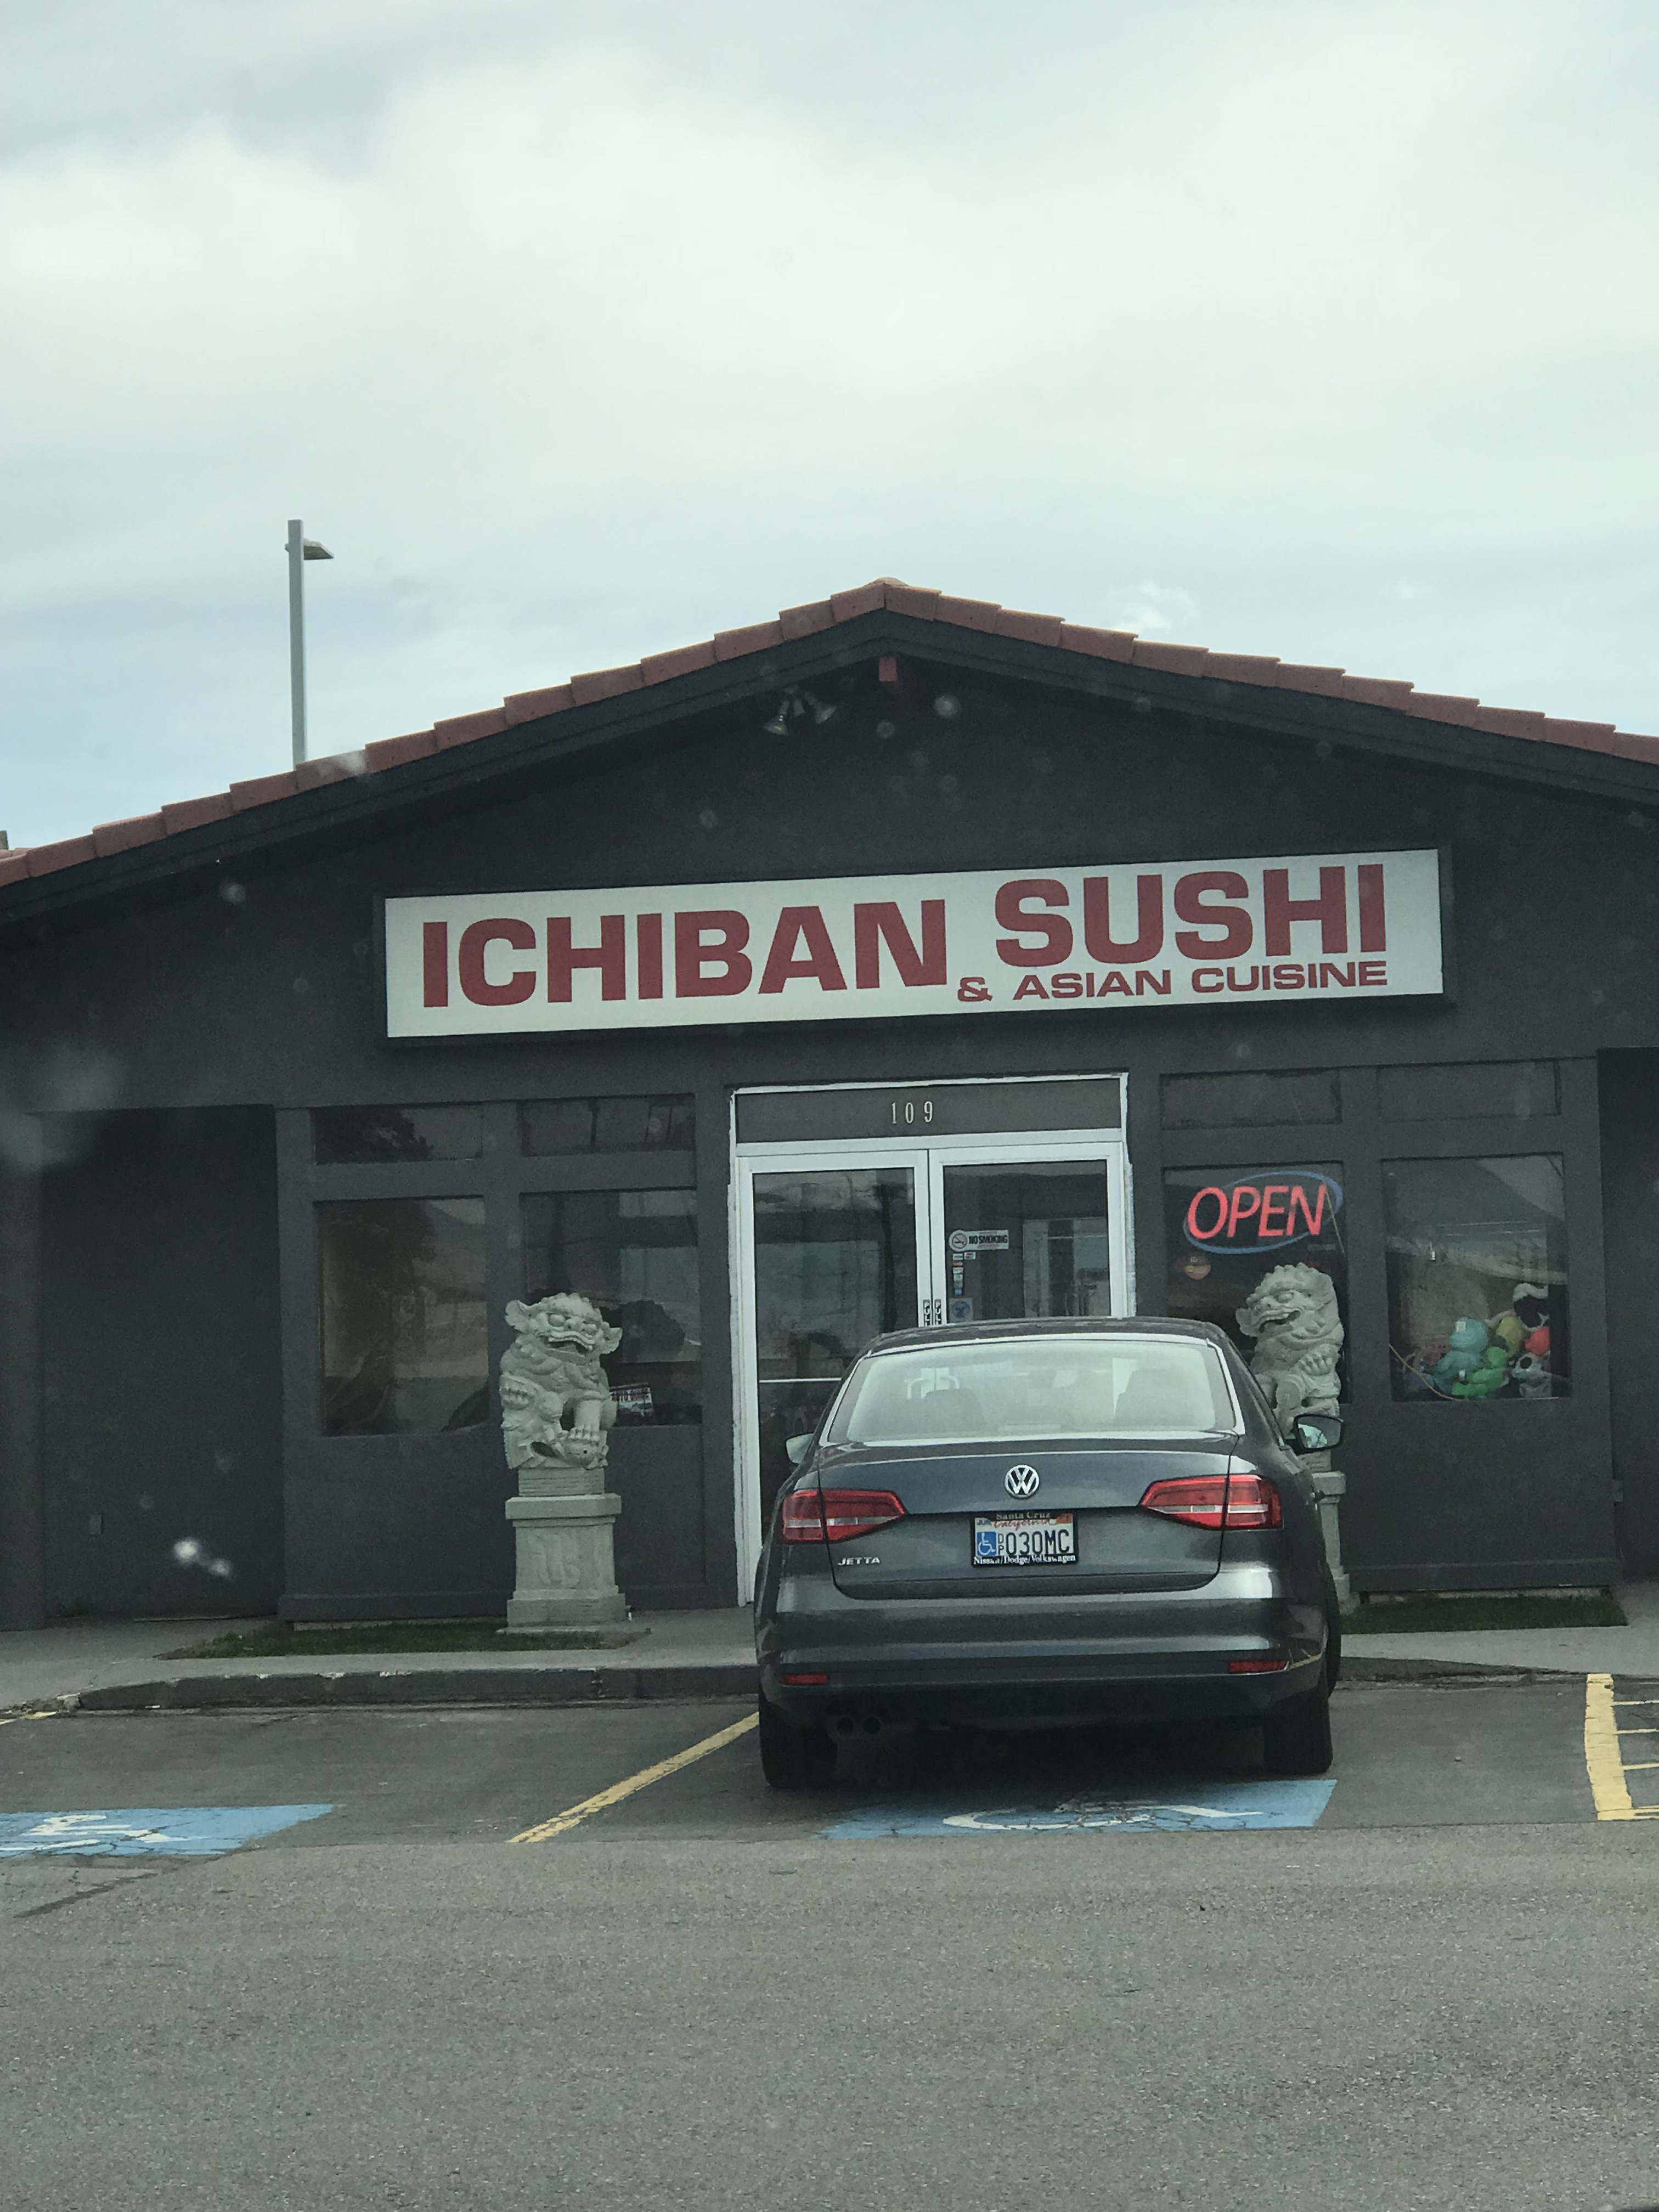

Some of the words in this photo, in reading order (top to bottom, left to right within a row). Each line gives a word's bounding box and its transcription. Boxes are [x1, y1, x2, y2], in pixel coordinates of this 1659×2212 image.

[423, 899, 947, 1008] ICHIBAN
[994, 864, 1387, 968] SUSHI
[957, 976, 993, 1003] &
[1012, 969, 1172, 1001] ASIAN
[1191, 960, 1388, 994] CUISINE
[891, 1101, 933, 1125] 109
[1187, 1184, 1328, 1240] OPEN
[968, 1235, 978, 1245] NO
[979, 1234, 1008, 1245] SMOKING
[996, 1512, 1024, 1520] Santa
[1026, 1511, 1051, 1519] Cruz
[837, 1556, 881, 1566] JETTA
